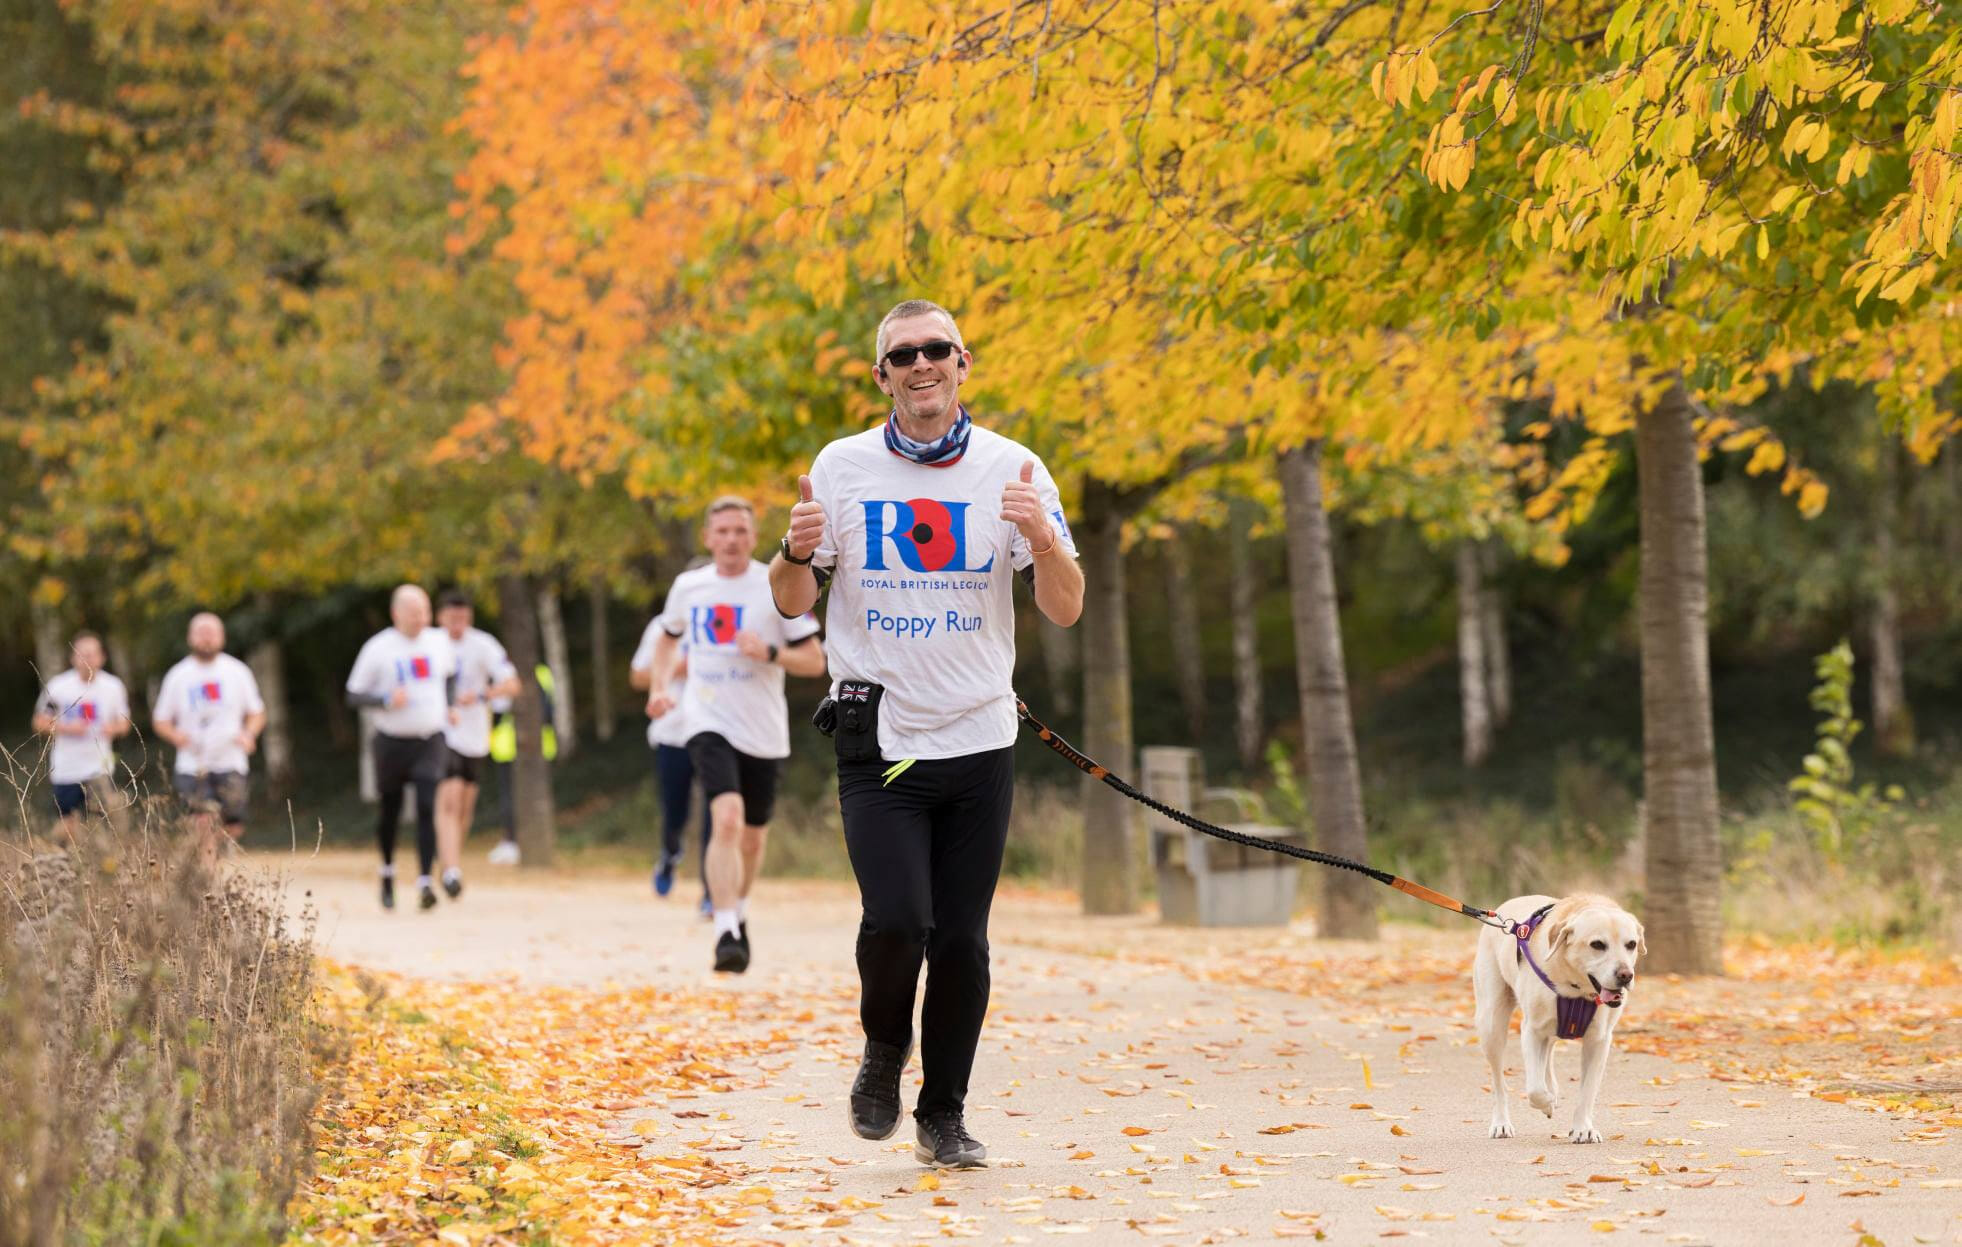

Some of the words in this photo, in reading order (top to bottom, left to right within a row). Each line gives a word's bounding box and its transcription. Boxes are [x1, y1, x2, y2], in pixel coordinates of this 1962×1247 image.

[861, 578, 897, 589] ROYAL
[901, 580, 949, 590] BRITISH
[952, 581, 989, 591] LEGION
[867, 608, 936, 638] Poppy
[946, 610, 982, 632] Run
